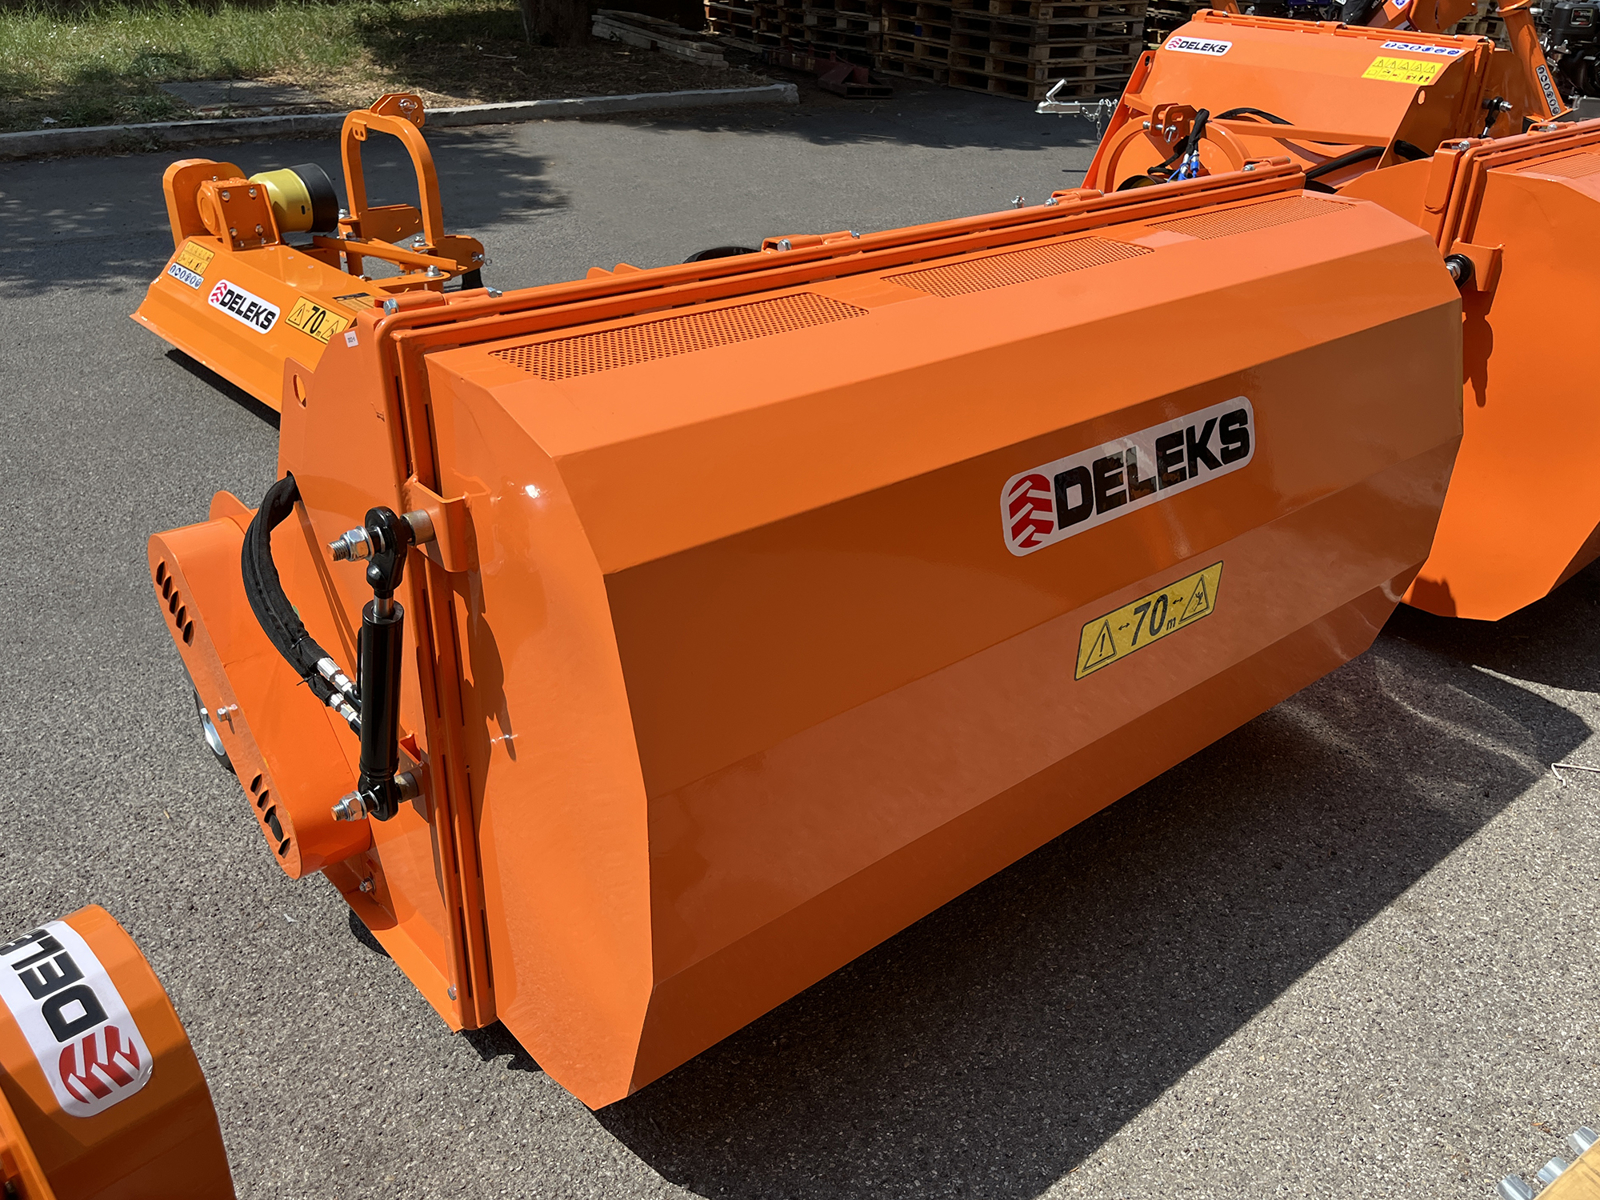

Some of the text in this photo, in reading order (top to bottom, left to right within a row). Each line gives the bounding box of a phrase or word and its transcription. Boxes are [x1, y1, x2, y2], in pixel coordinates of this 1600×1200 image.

[1178, 40, 1228, 53] DELEKS
[220, 289, 276, 331] DELEKS
[1053, 408, 1250, 531] DELEKS
